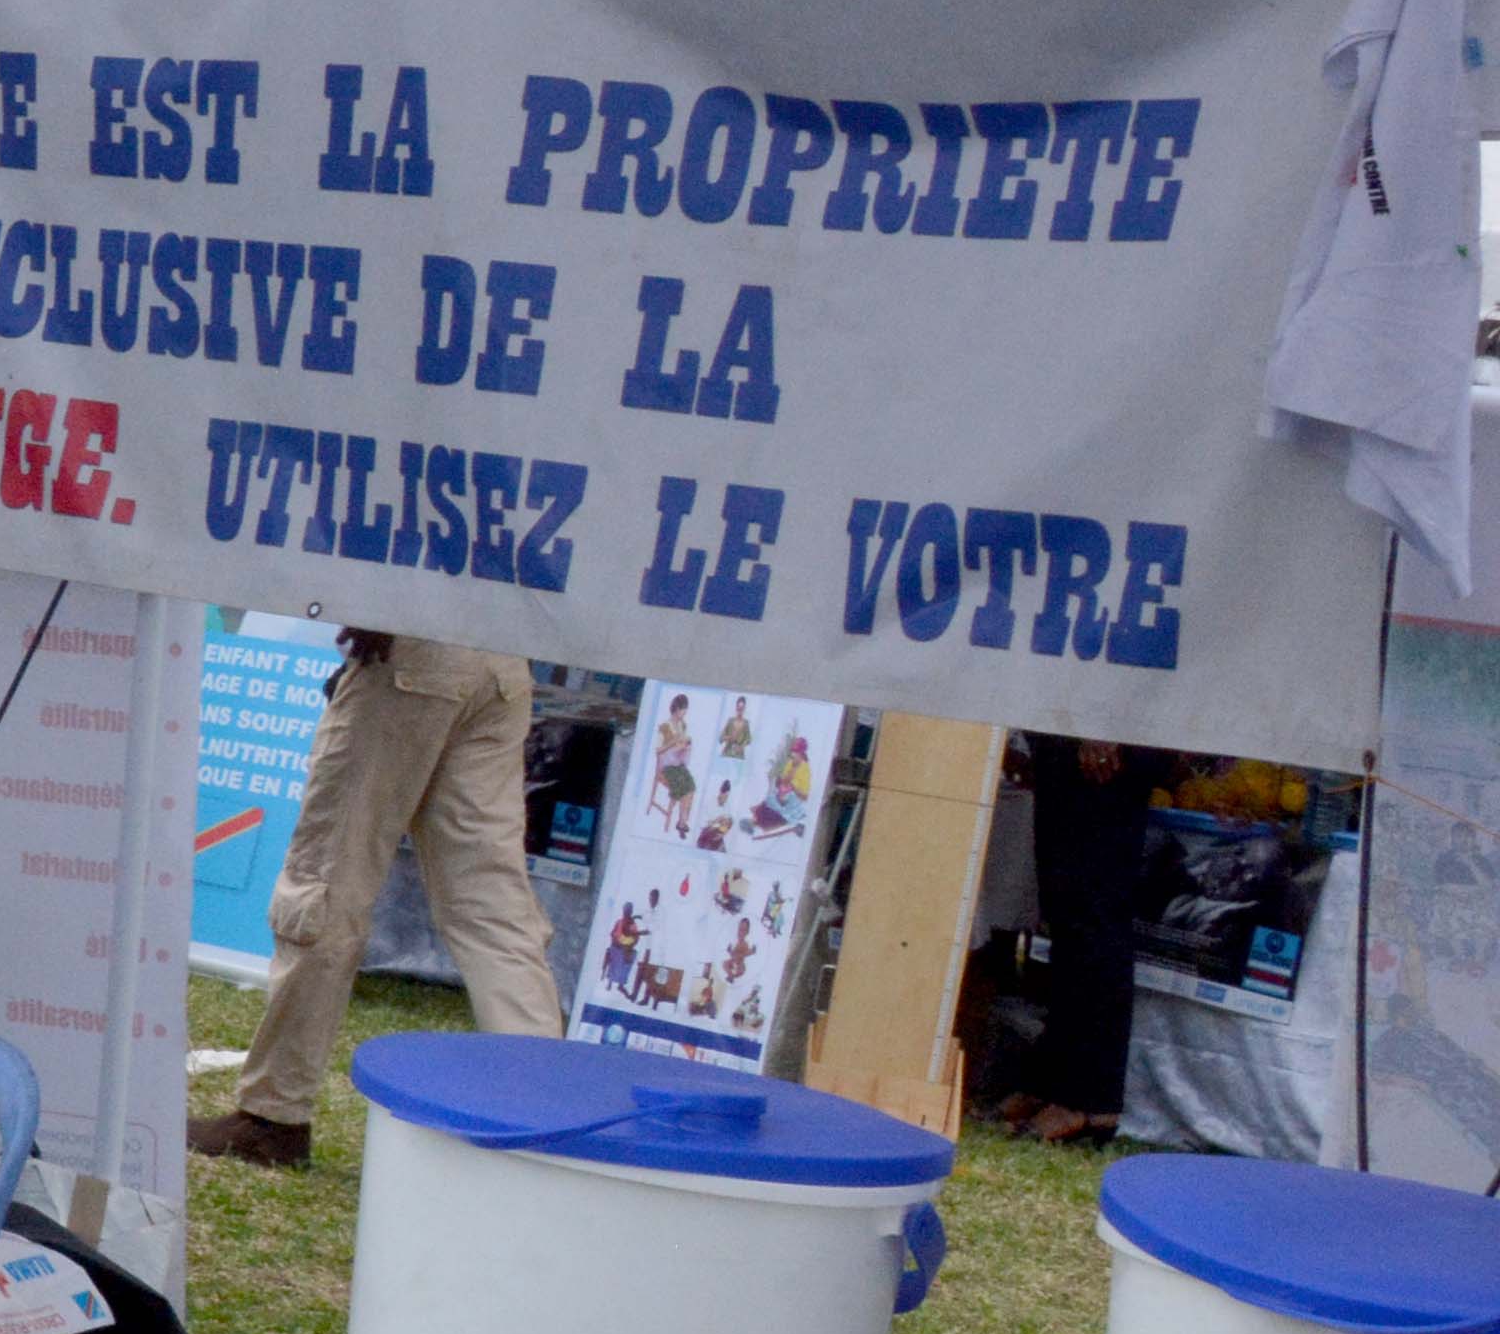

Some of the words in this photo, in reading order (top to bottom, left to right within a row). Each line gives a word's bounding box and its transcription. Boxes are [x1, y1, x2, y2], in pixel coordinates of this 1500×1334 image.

[89, 56, 259, 185] EST
[318, 64, 434, 198] LA
[505, 74, 1201, 243] PROPRIETE
[415, 255, 558, 397] DE
[621, 275, 780, 425] LA
[205, 417, 588, 593] UTILISEZ
[639, 474, 786, 622] LE
[842, 497, 1188, 671] VOTRE
[204, 643, 289, 673] ENFANT
[202, 673, 243, 695] AGE
[248, 678, 279, 702] DE
[285, 685, 328, 709] MO
[237, 709, 315, 740] SOUFF
[199, 735, 310, 773] LNUTRITI
[198, 766, 244, 789] QUE
[250, 774, 281, 797] EN
[286, 781, 303, 801] R
